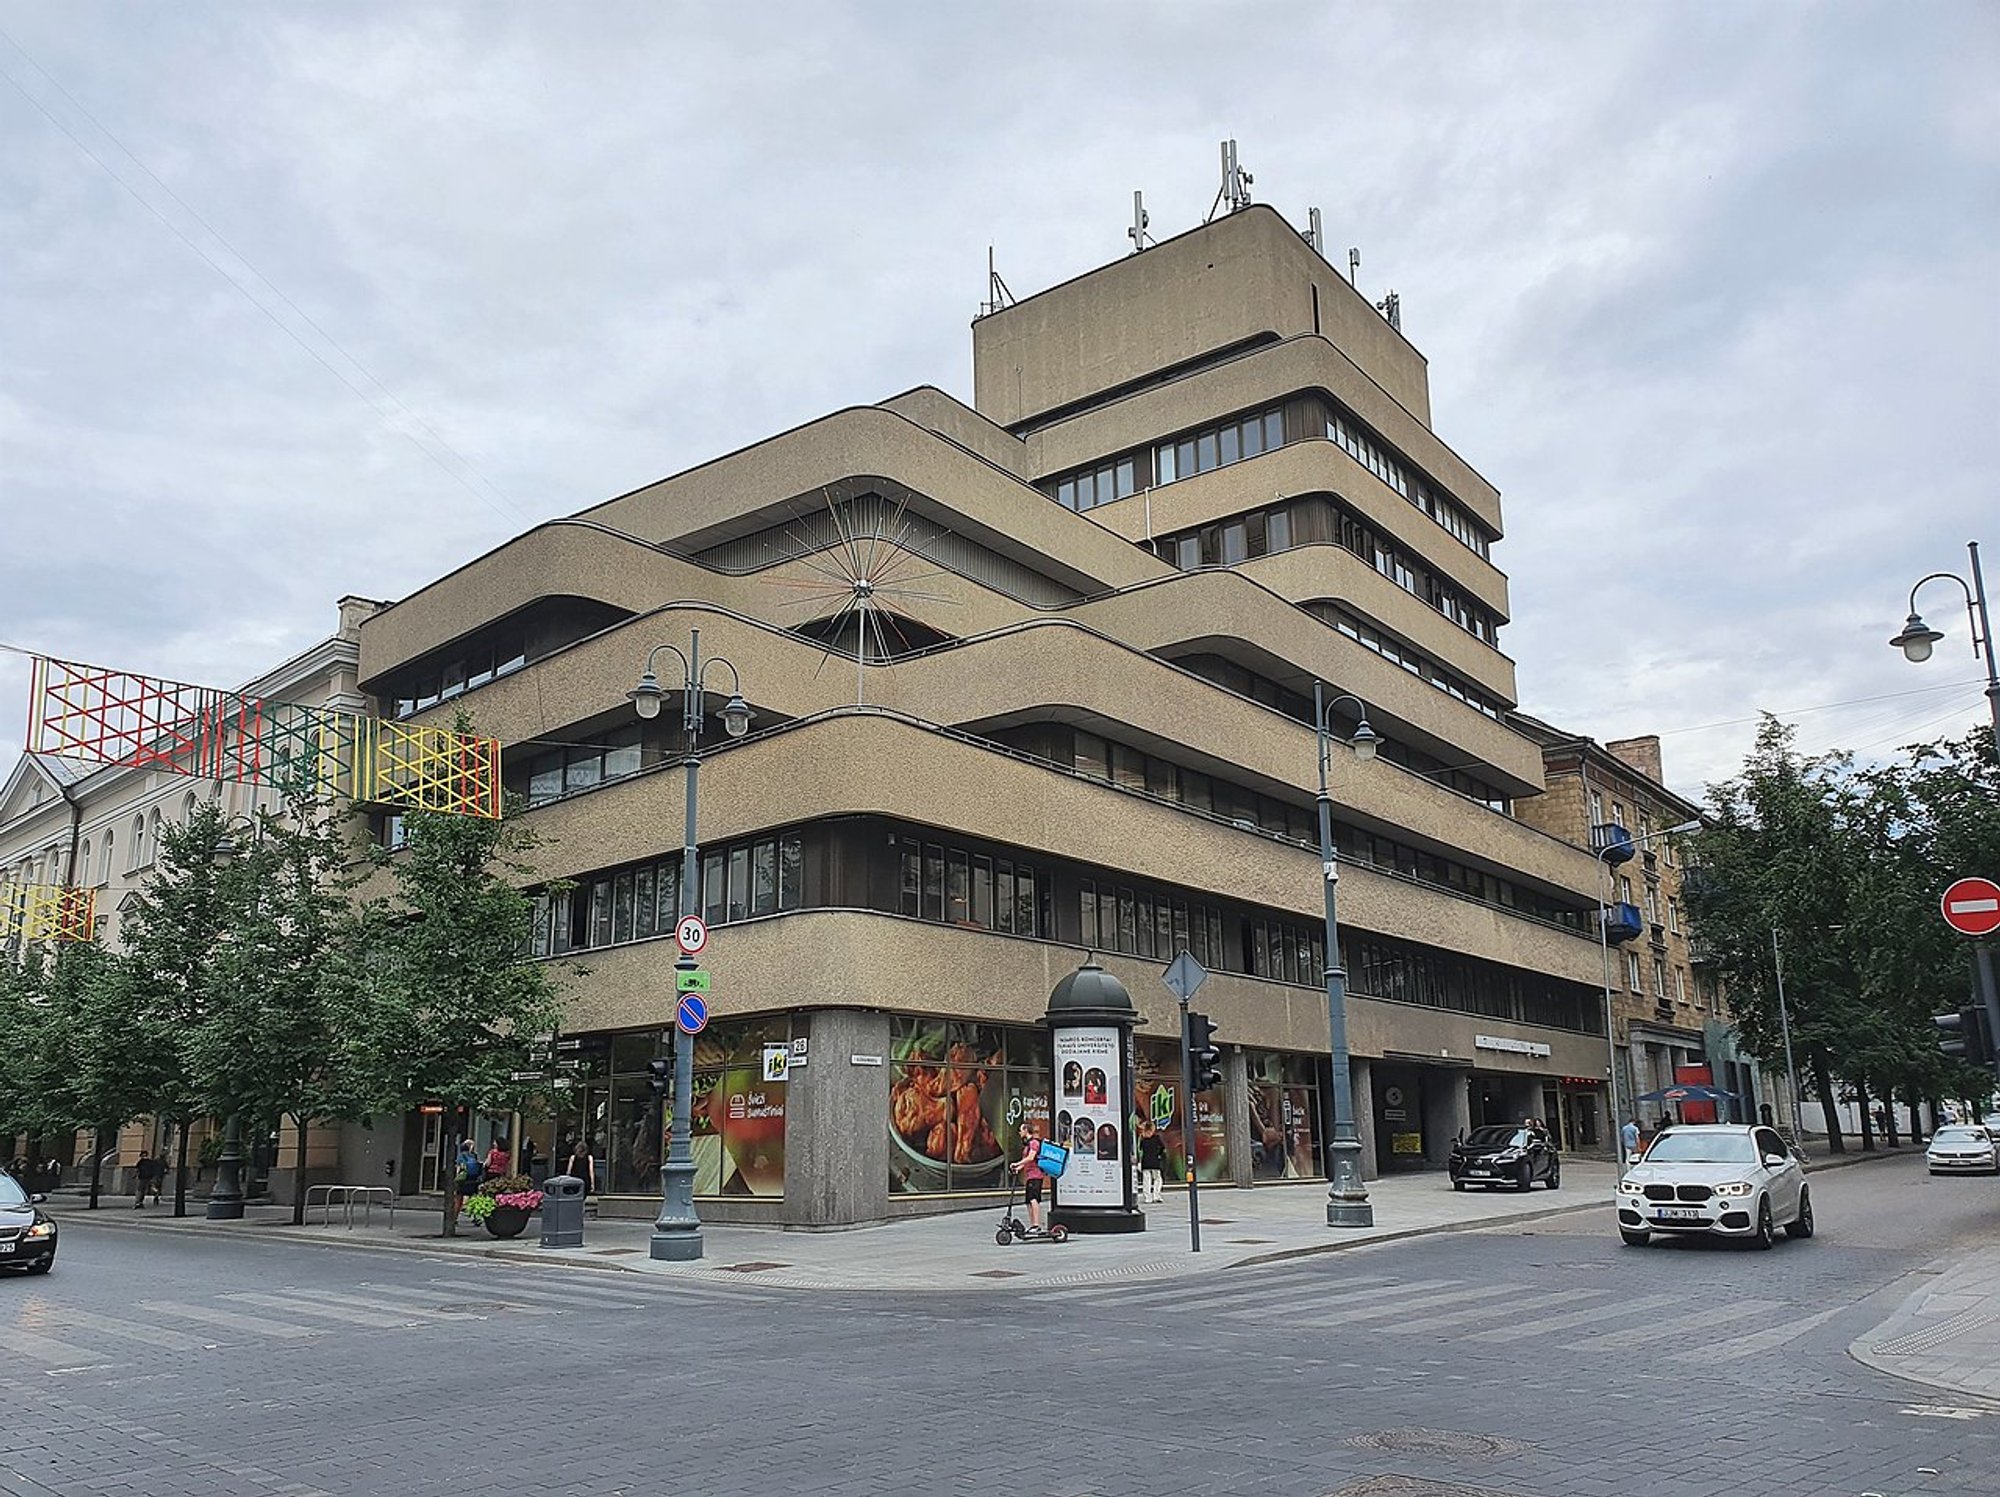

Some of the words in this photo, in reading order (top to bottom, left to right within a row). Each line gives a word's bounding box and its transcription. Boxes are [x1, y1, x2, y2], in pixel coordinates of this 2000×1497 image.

[683, 927, 700, 943] 30
[767, 1054, 787, 1074] iki
[1150, 1086, 1175, 1121] iki
